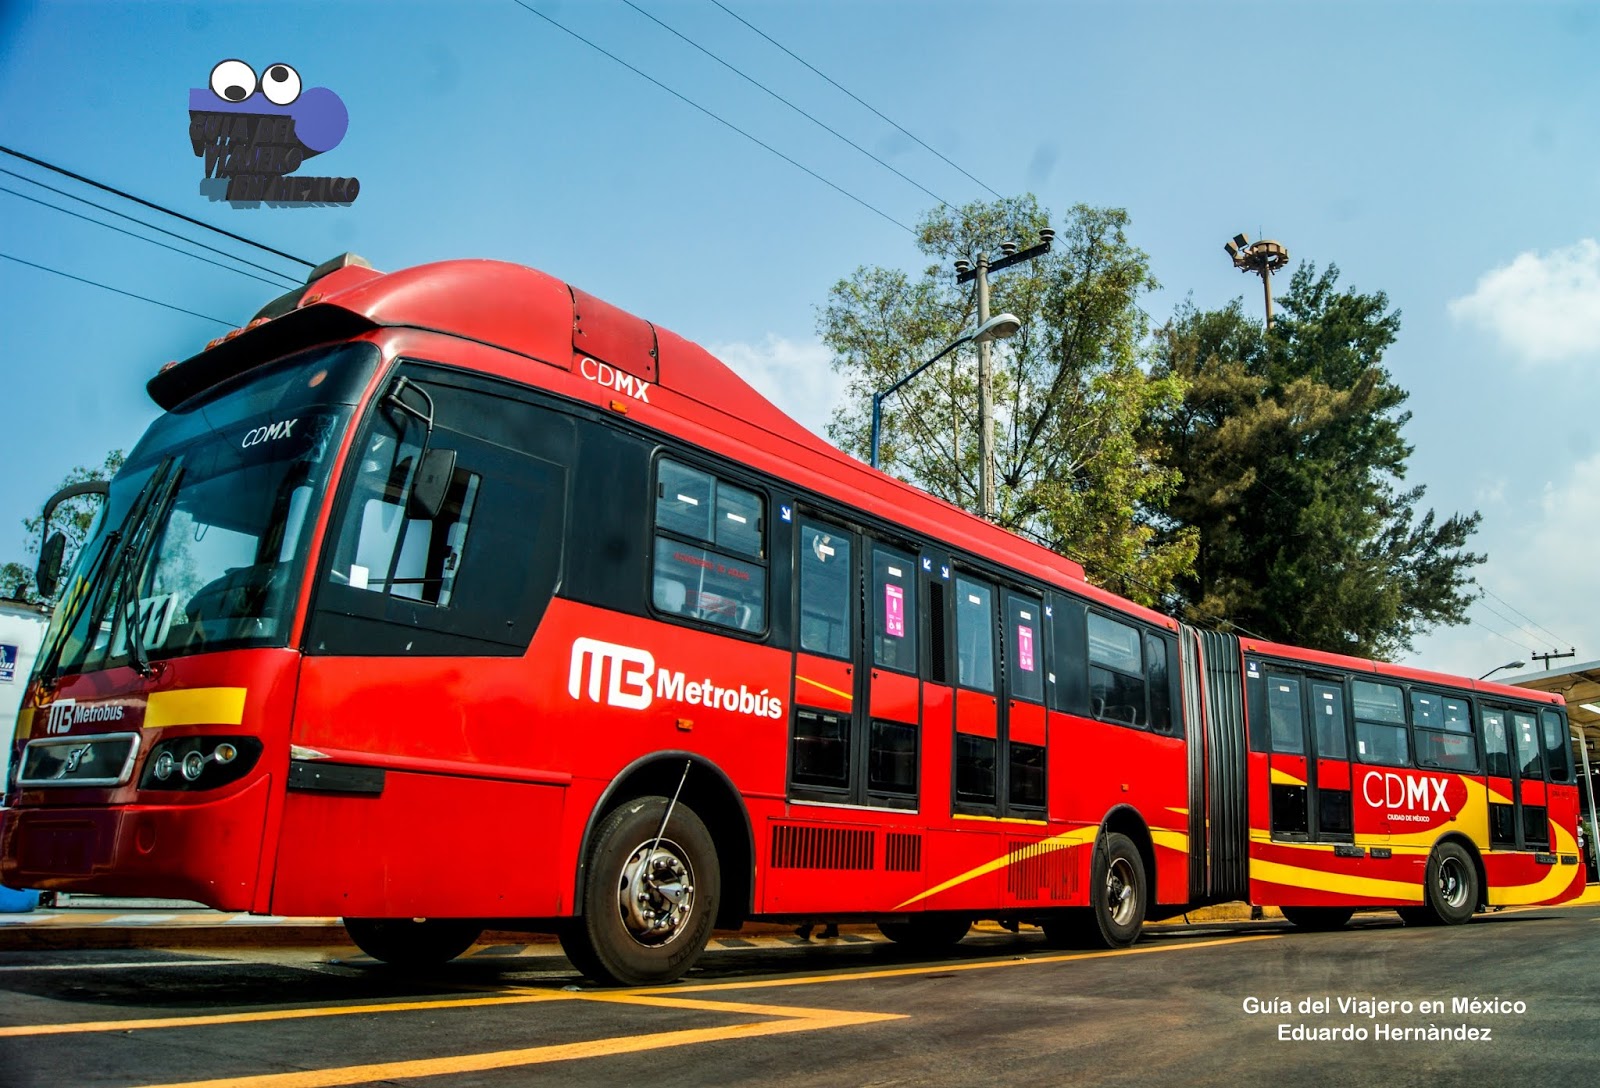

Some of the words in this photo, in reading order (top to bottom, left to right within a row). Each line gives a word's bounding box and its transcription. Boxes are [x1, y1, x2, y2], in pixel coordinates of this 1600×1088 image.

[580, 357, 651, 405] CDMX
[241, 418, 299, 449] CDMX
[656, 668, 783, 720] Metrobús
[73, 701, 124, 724] Metrobús
[1363, 771, 1451, 813] CDMX
[1387, 813, 1405, 821] CIUDAD
